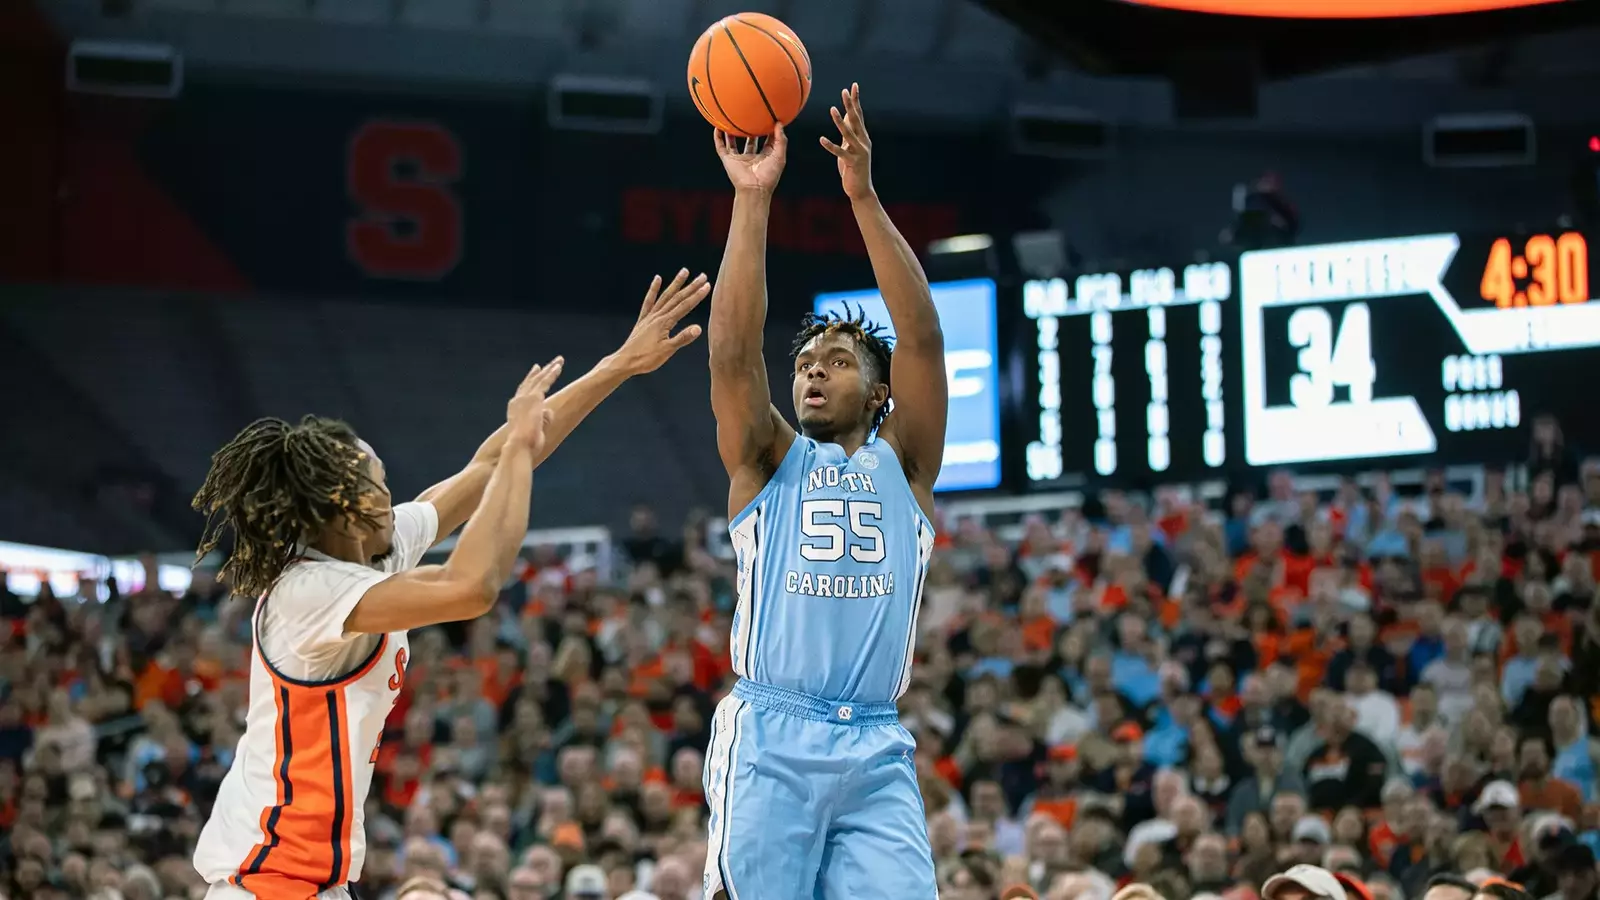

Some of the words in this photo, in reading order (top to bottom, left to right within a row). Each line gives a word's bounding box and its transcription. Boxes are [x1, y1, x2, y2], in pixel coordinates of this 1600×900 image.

[348, 121, 462, 279] S
[1480, 231, 1589, 309] 4:30
[1288, 302, 1376, 408] 34
[800, 499, 886, 564] 55
[785, 570, 894, 598] CAROLINA
